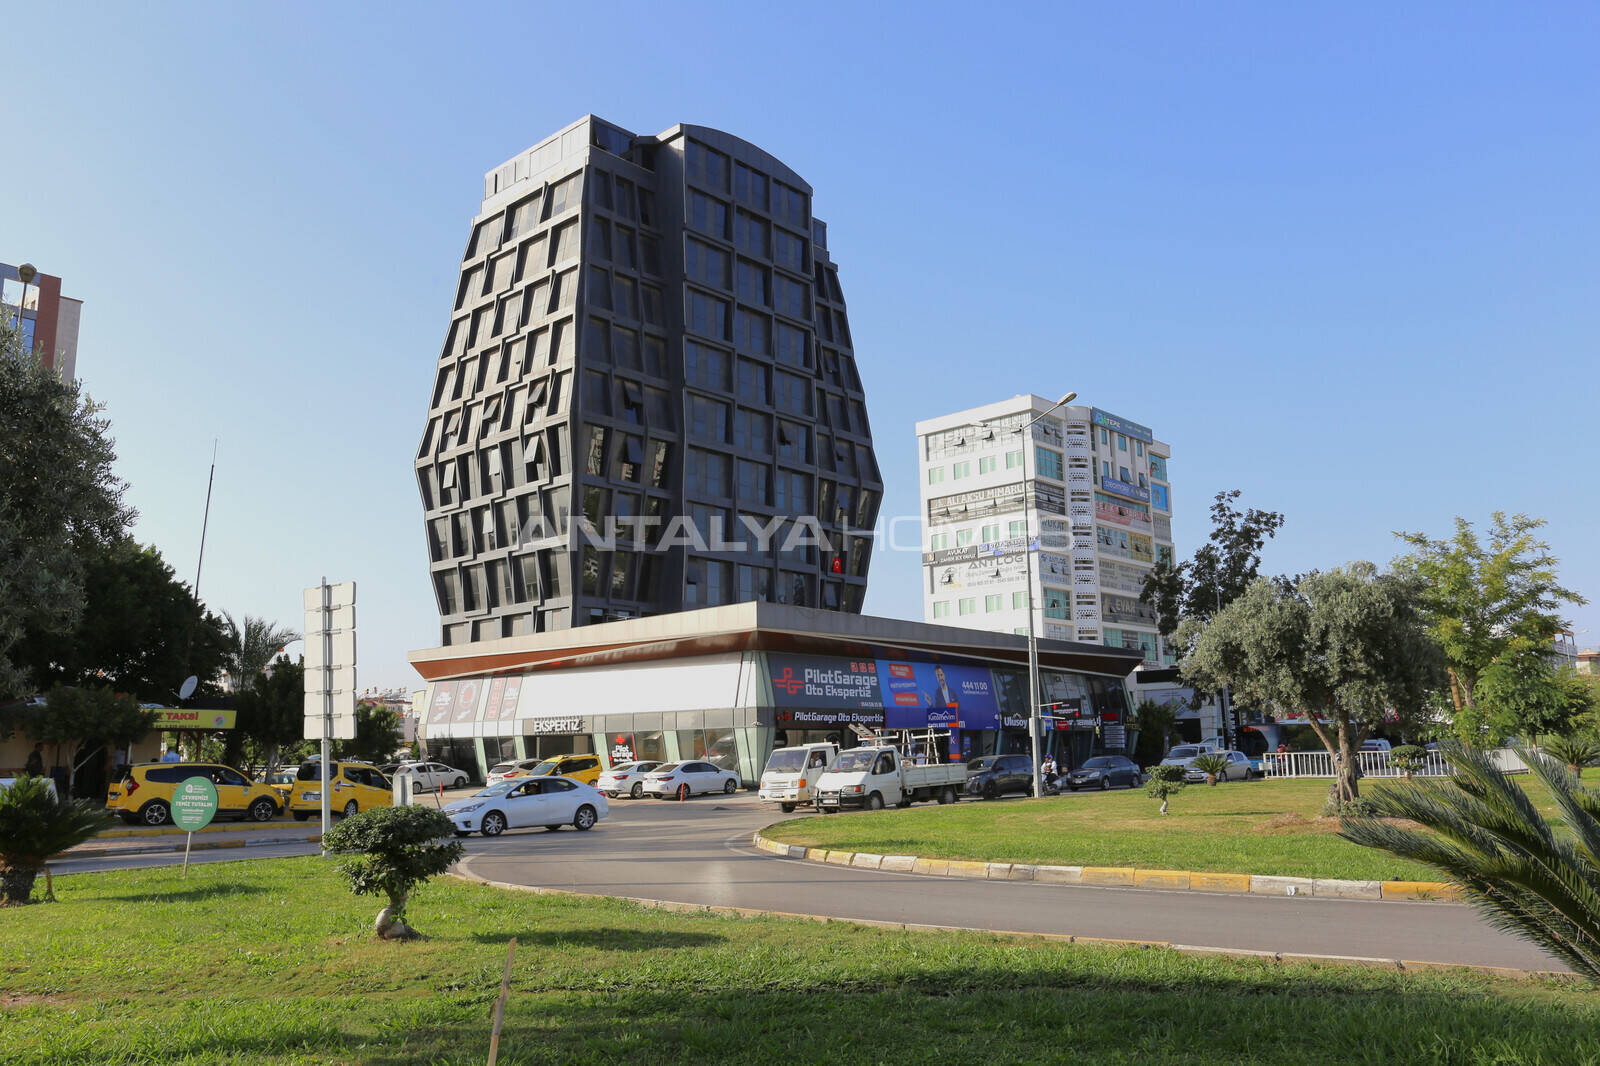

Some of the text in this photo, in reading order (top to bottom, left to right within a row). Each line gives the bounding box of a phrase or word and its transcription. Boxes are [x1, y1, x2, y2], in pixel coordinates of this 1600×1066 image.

[804, 668, 877, 689] PilotGarage
[805, 684, 872, 699] Oto Ekspertiz
[794, 711, 837, 723] PilotGarage
[837, 712, 851, 722] Oto
[1004, 716, 1028, 729] Ulusoy
